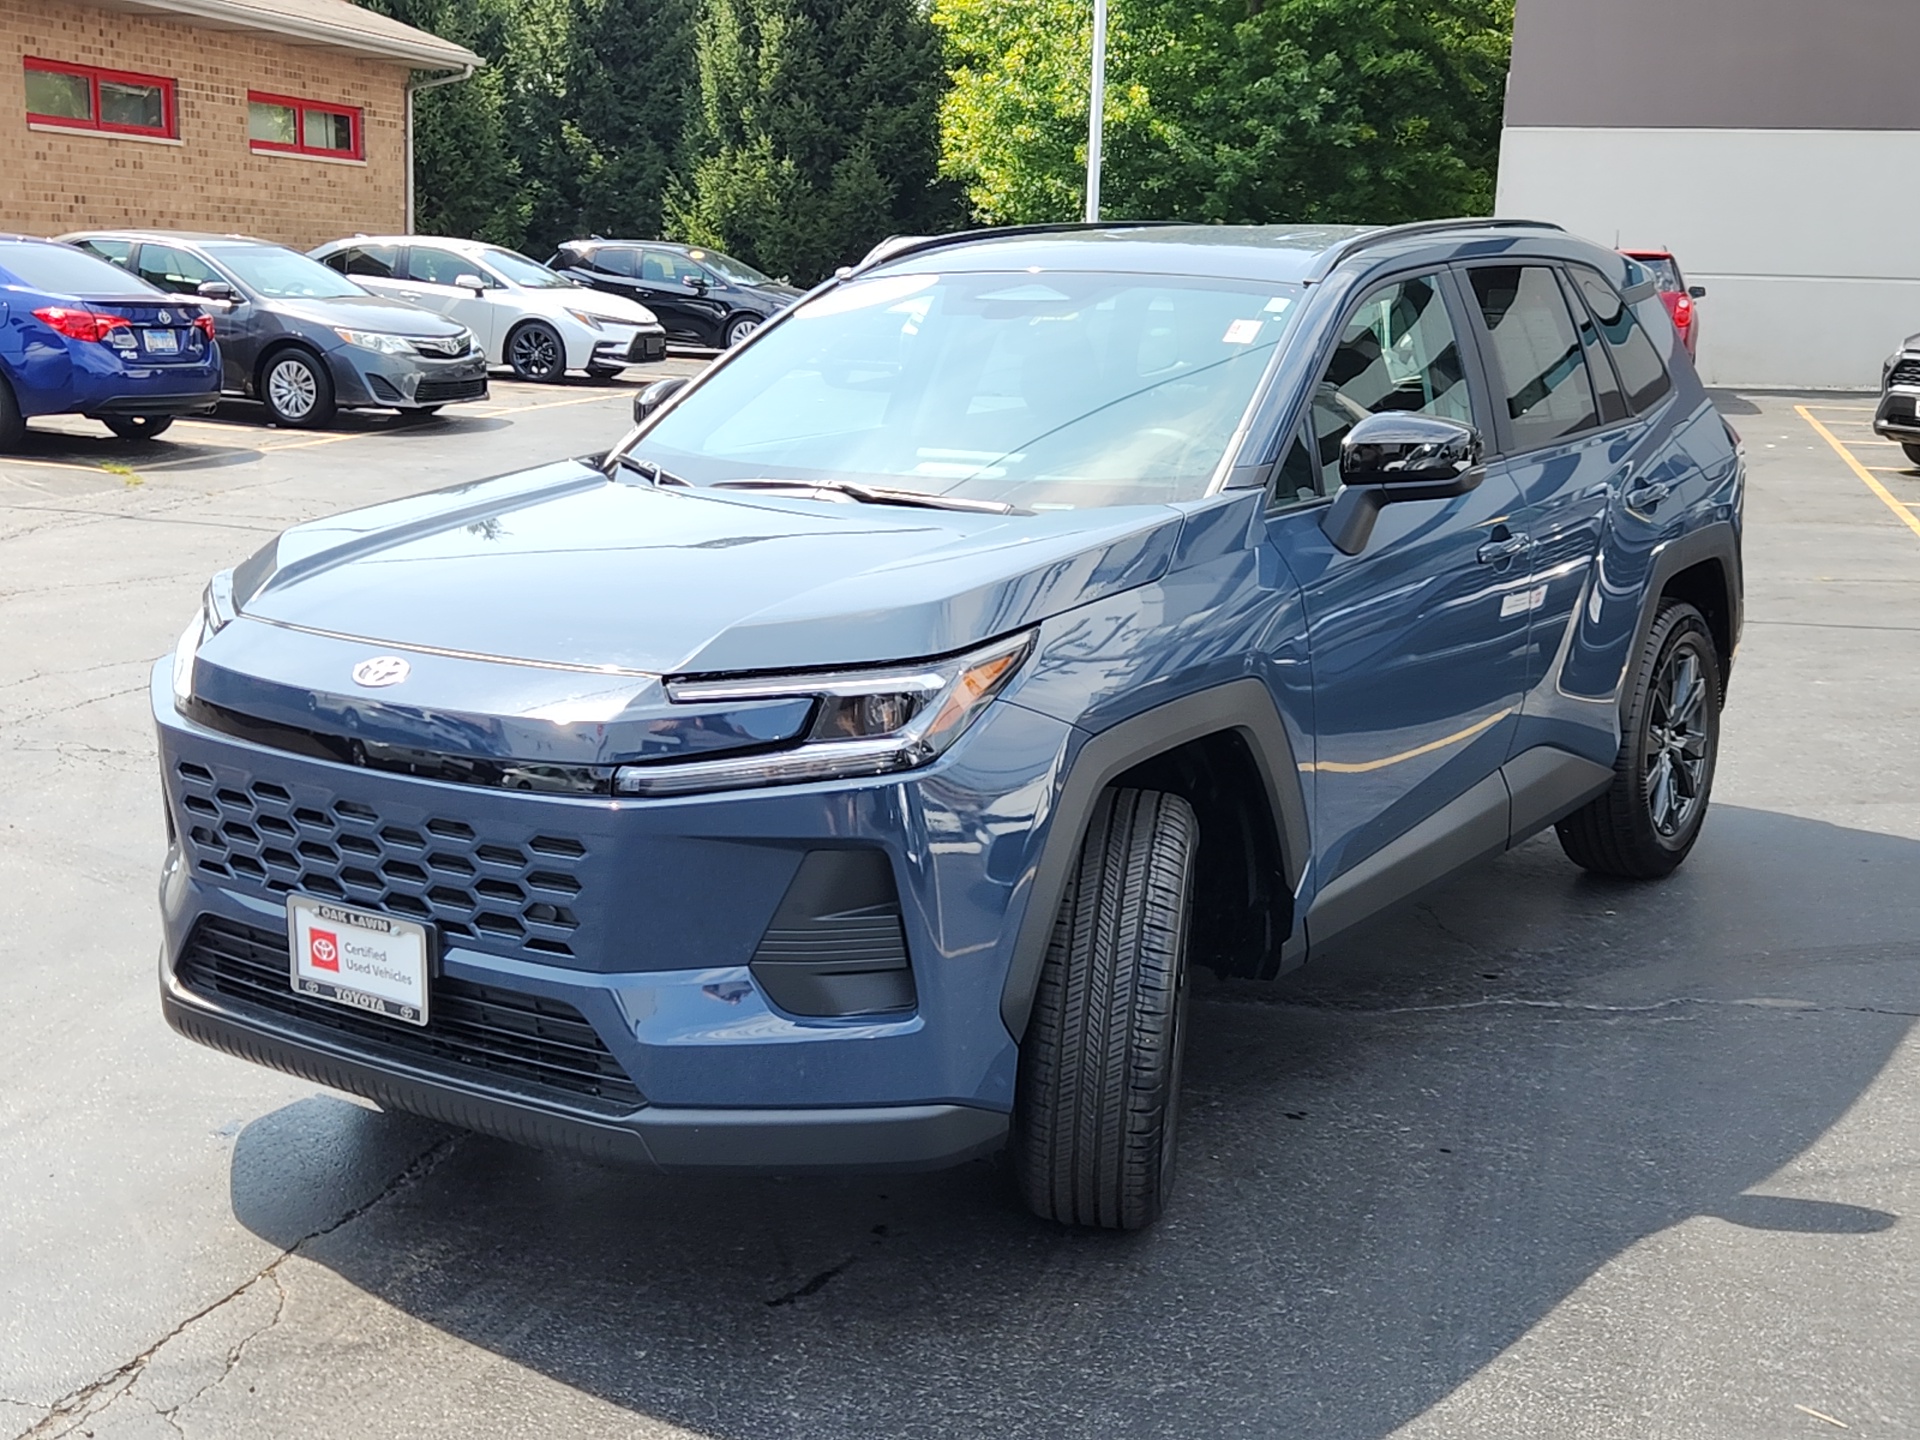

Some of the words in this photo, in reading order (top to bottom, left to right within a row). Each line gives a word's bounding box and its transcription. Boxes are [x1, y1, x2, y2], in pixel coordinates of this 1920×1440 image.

[321, 906, 348, 923] OAK
[350, 914, 389, 933] LAWN
[344, 941, 388, 963] Certified
[345, 958, 371, 975] Used
[372, 964, 413, 986] Vehicles
[334, 987, 386, 1012] TOYOTA
